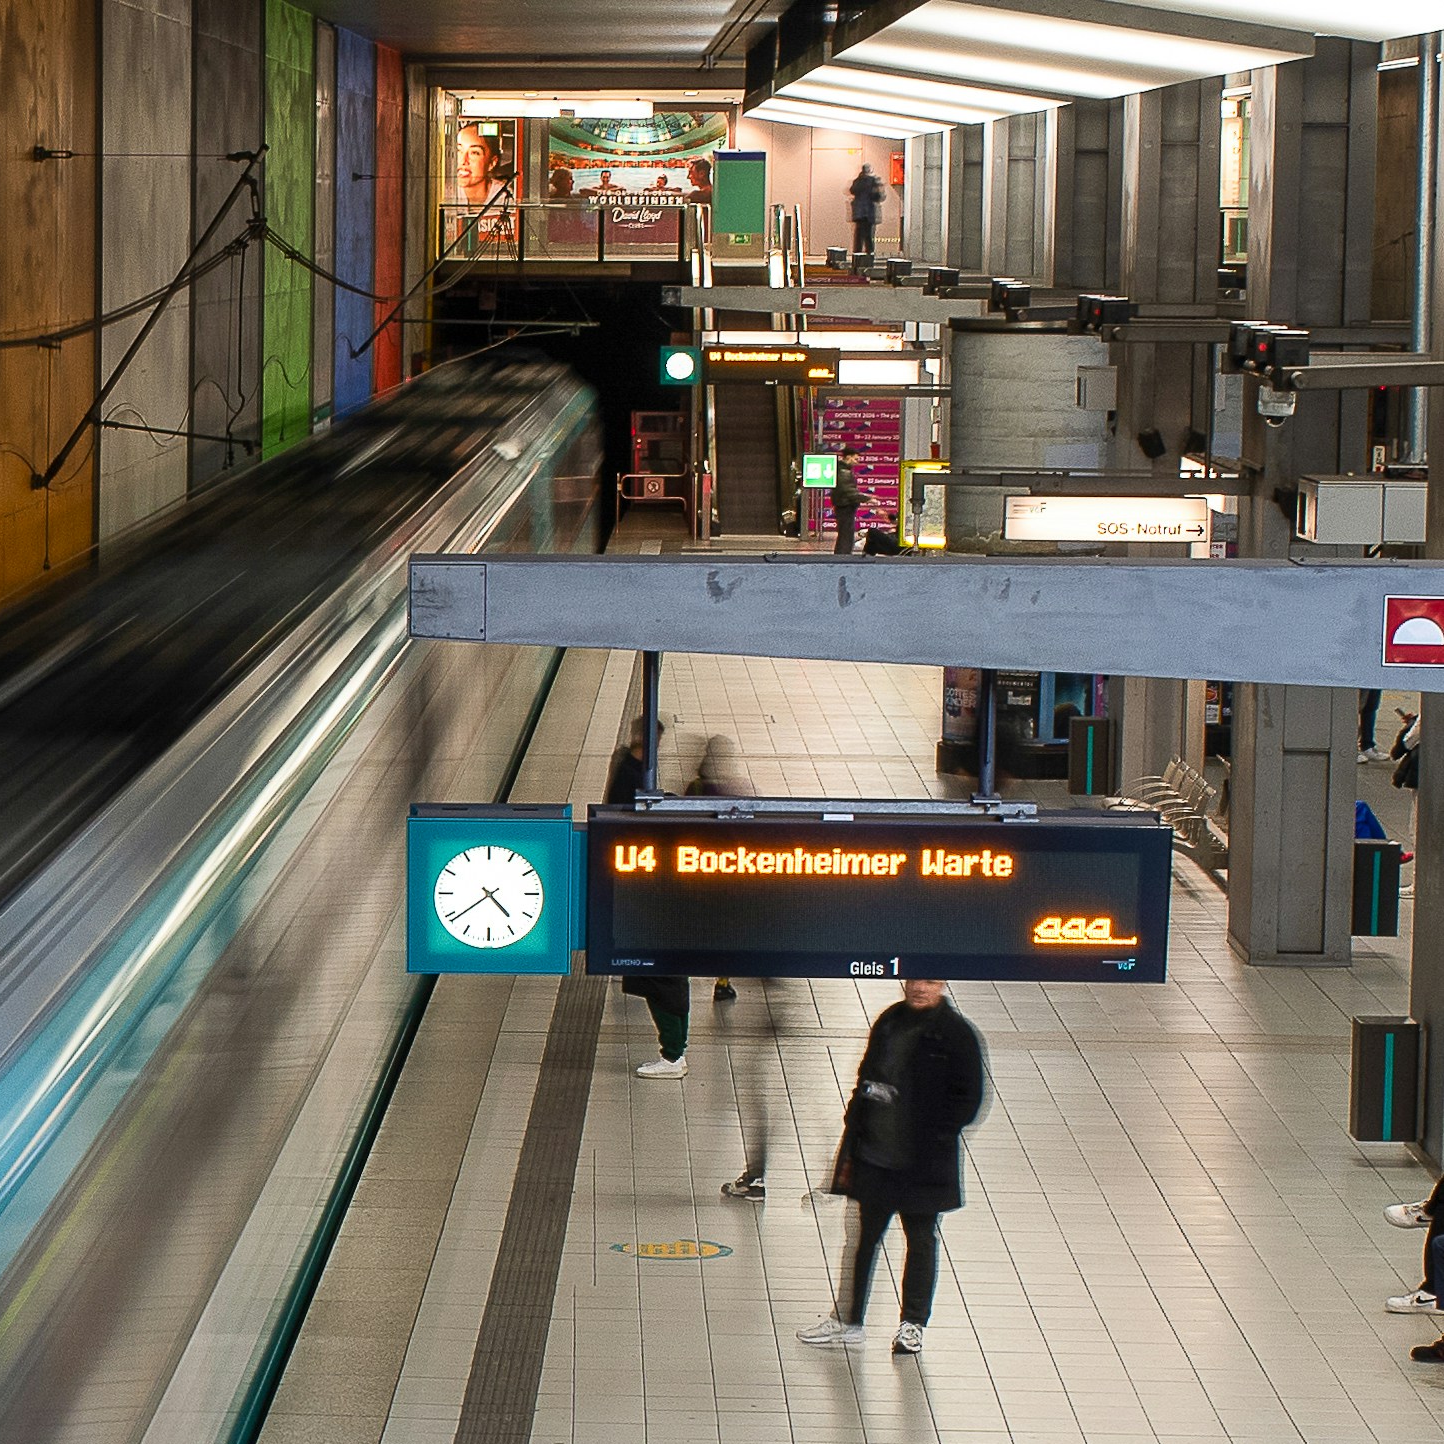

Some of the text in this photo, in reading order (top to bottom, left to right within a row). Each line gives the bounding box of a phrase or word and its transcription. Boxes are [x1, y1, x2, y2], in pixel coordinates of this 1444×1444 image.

[615, 845, 1013, 877] U4 Bockenheimer Warte
[850, 957, 899, 976] Gleis 1
